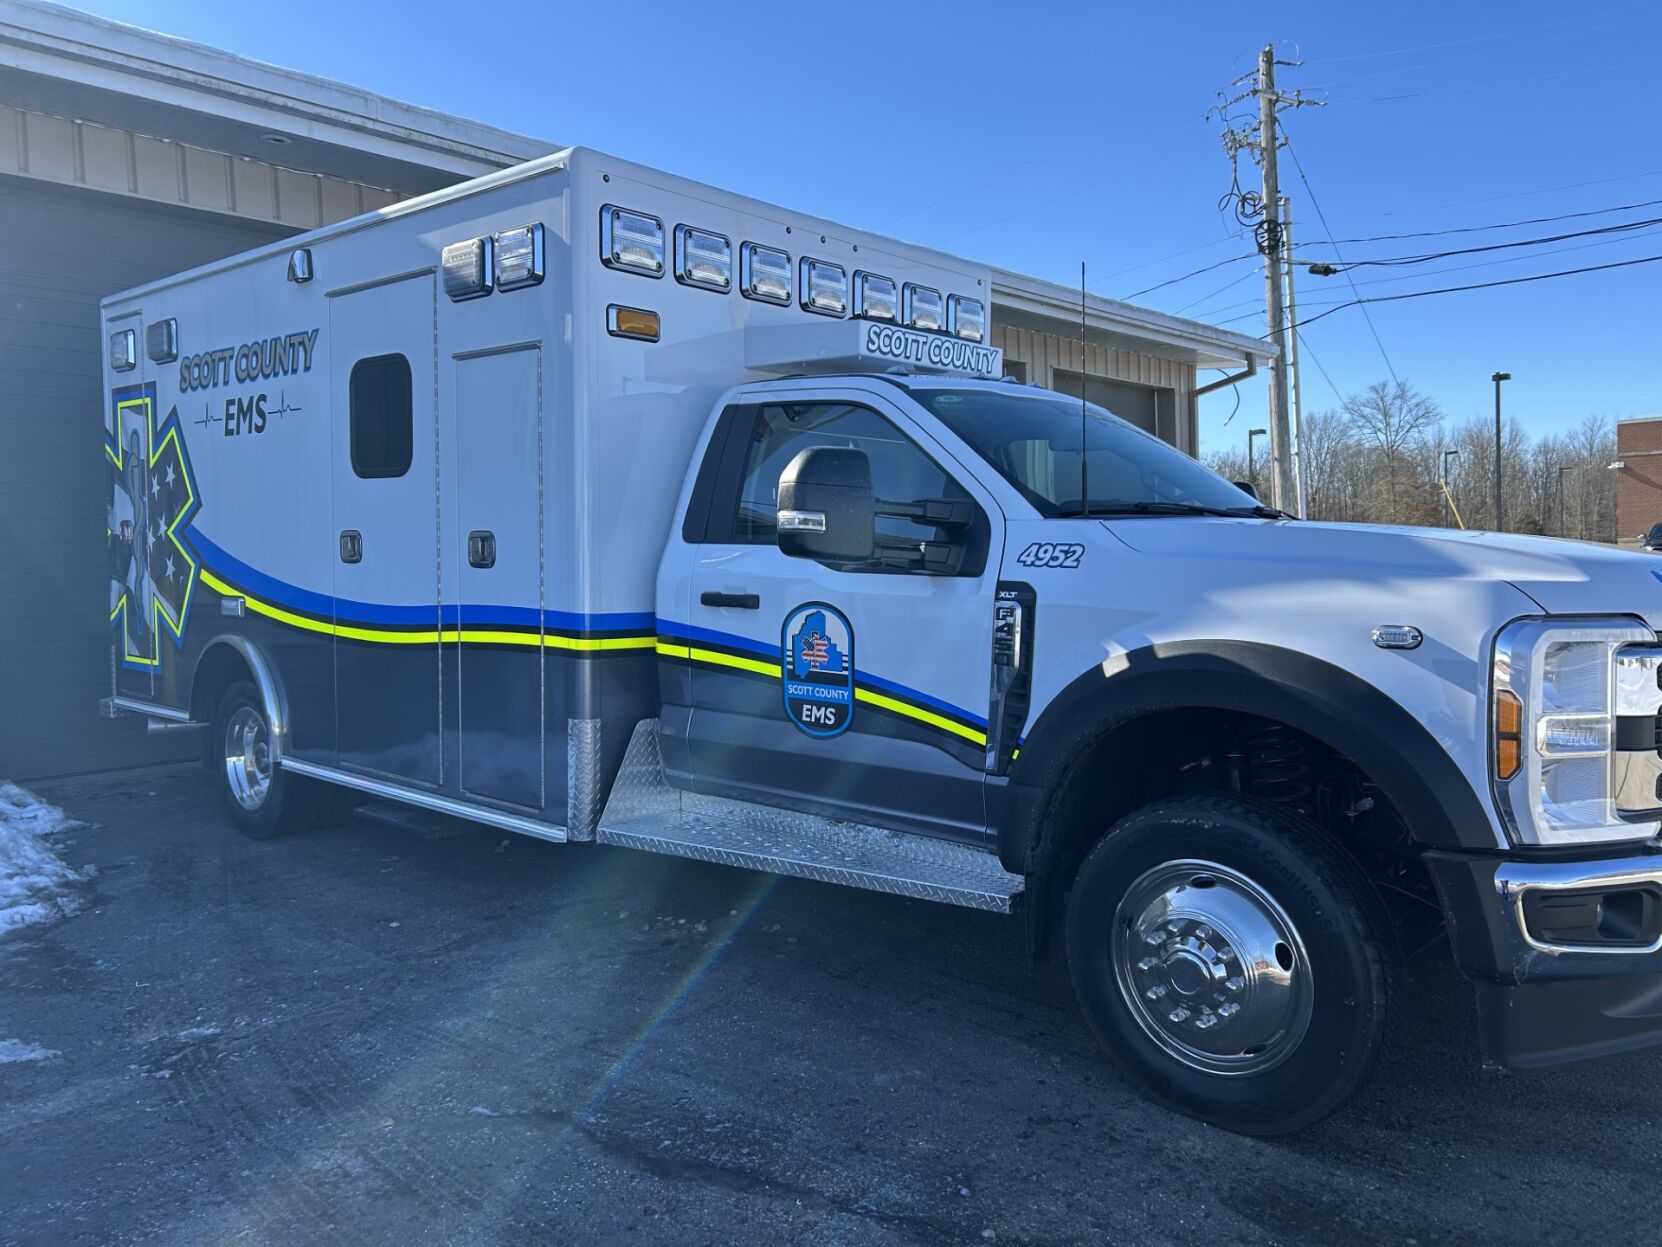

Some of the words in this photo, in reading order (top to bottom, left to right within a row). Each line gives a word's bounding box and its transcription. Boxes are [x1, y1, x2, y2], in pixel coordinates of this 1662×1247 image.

[180, 346, 235, 393] SCOTT
[235, 328, 320, 384] COUNTY
[867, 323, 929, 362] SCOTT
[928, 338, 998, 373] COUNTY
[225, 393, 267, 437] EMS
[1017, 543, 1085, 568] 4952
[788, 684, 814, 696] SCOTT
[815, 688, 849, 700] COUNTY
[802, 704, 836, 725] EMS
